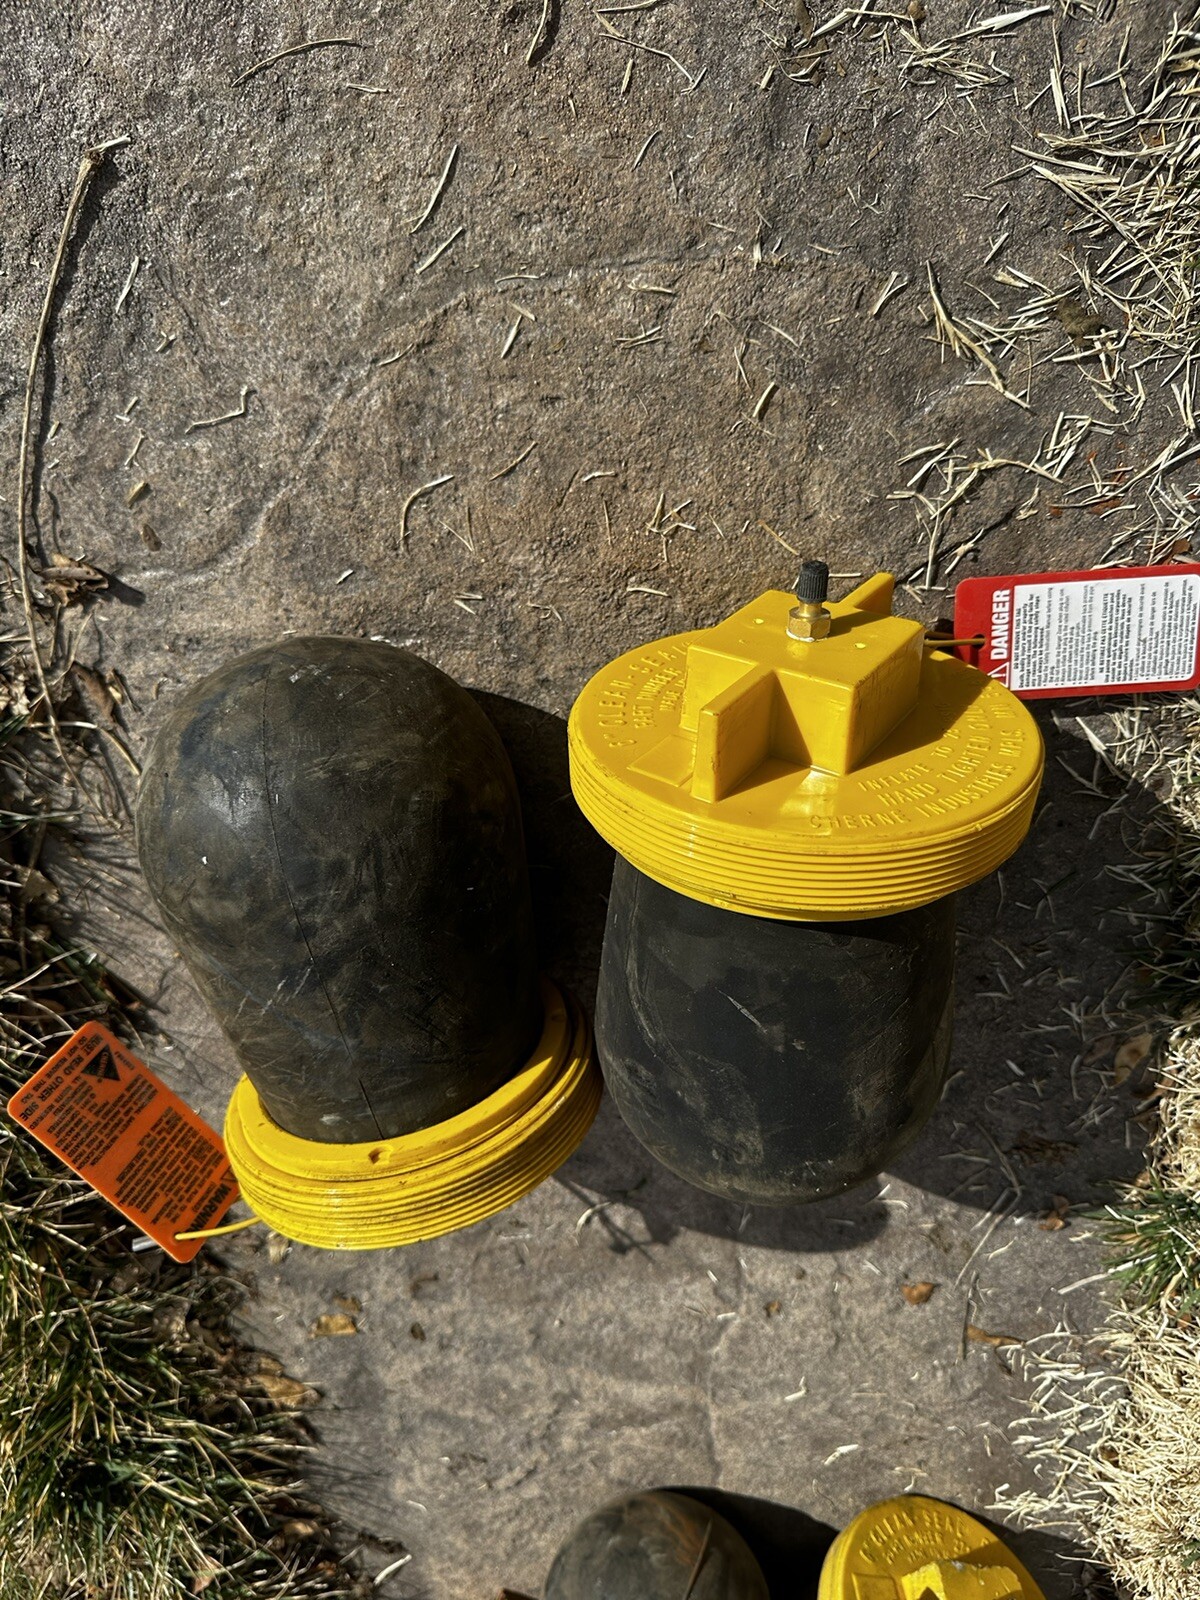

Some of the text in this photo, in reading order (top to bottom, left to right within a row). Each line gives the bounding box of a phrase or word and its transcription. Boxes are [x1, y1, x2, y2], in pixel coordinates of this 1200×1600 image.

[990, 589, 1010, 659] DANGER
[809, 809, 911, 831] CHERNE
[914, 764, 1017, 819] INDUSTRIES
[858, 762, 933, 792] INFLATE
[930, 744, 952, 758] TO
[877, 782, 940, 807] HAND
[936, 738, 992, 784] TIGHTEN
[18, 1033, 103, 1122] MUST READ OTHER SIDE
[20, 1035, 87, 1105] DO NOT REMOVE THIS TAG
